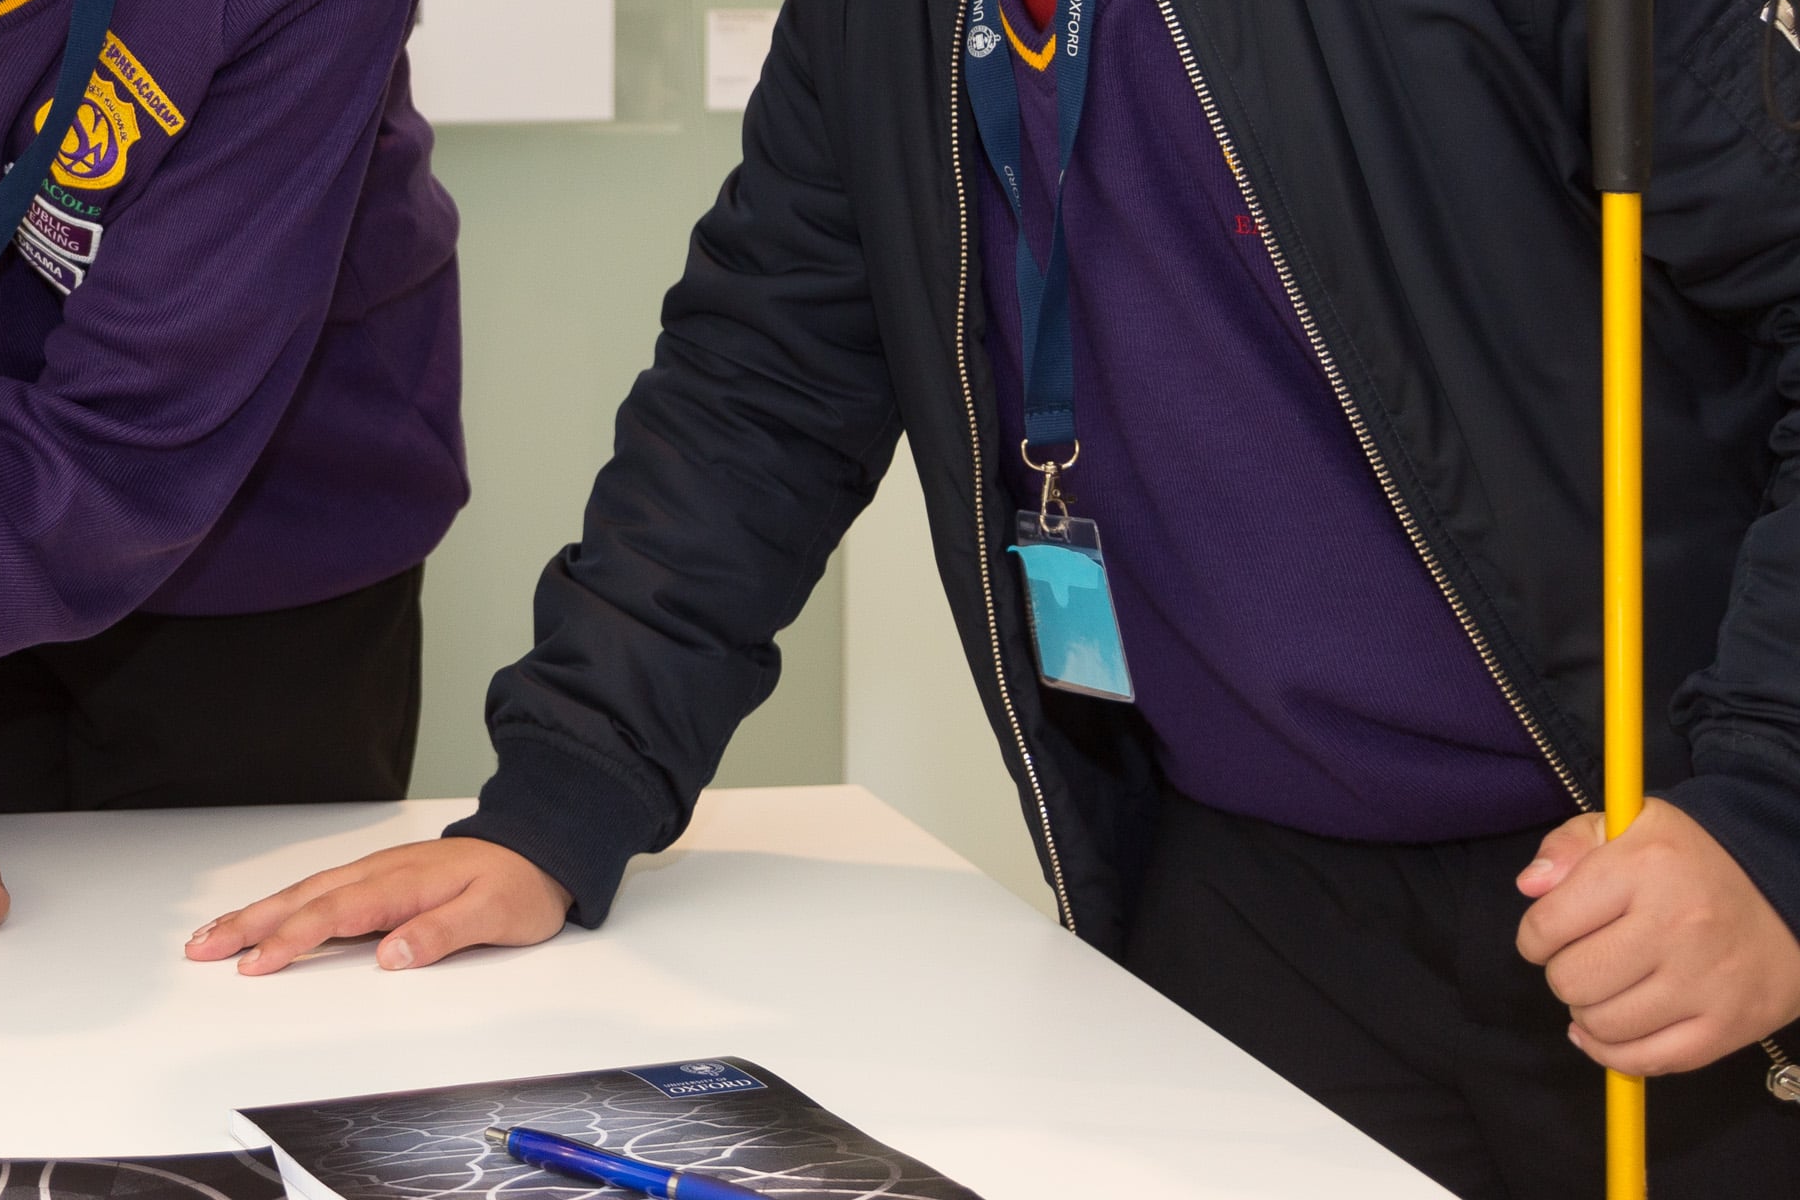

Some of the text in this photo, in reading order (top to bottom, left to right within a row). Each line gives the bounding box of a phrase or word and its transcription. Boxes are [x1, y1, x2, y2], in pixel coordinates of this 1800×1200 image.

[106, 44, 179, 127] SPIRES ACADEMY
[41, 179, 101, 216] ACOLE
[29, 210, 80, 251] EAKING
[33, 203, 71, 237] UBLIC
[663, 1079, 713, 1088] UNIVERSITY
[670, 1079, 751, 1094] OXFORD
